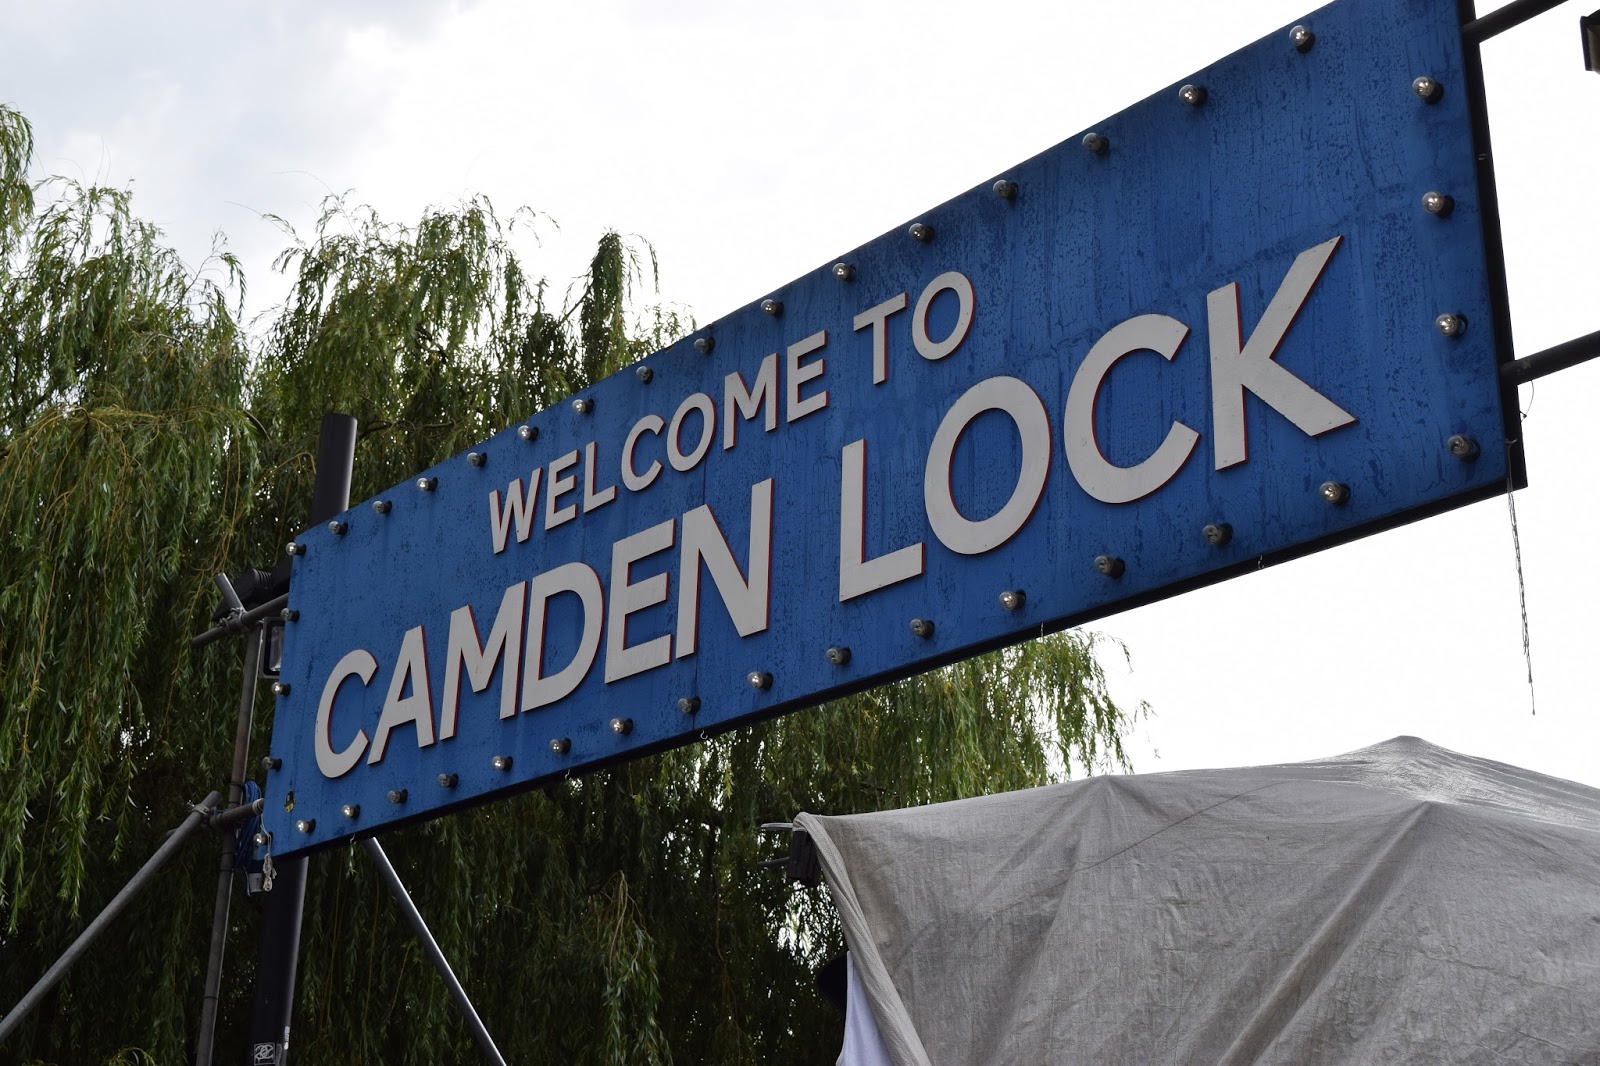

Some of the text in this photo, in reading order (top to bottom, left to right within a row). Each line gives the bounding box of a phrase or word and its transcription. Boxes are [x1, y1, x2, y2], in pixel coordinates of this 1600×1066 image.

[313, 235, 1355, 779] CAMDEN LOCK
[488, 271, 976, 555] WELCOME TO
